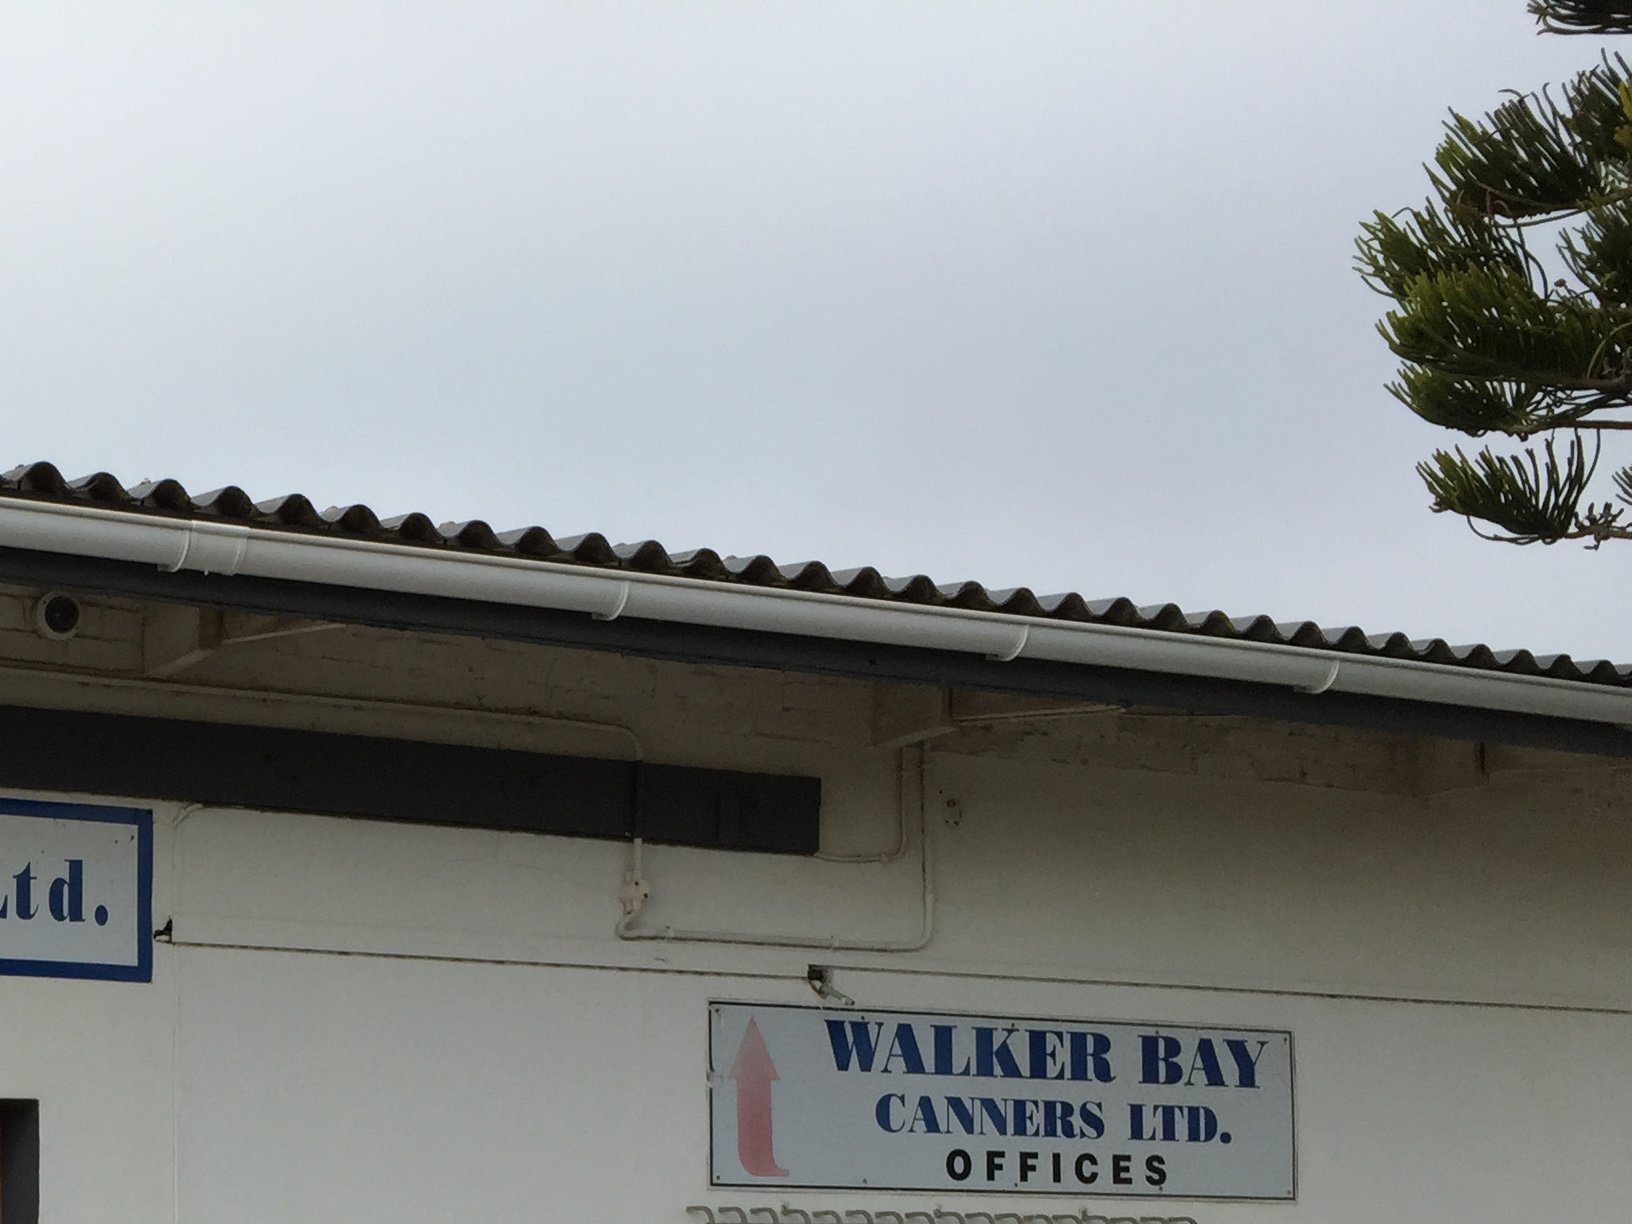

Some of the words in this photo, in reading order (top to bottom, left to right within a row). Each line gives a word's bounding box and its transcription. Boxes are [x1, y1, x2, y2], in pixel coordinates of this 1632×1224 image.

[823, 1018, 1116, 1084] WALKER
[1137, 1033, 1270, 1090] BAY
[874, 1092, 1106, 1141] CANNERS
[1127, 1103, 1233, 1145] LTD.
[945, 1148, 1169, 1187] OFFICES
